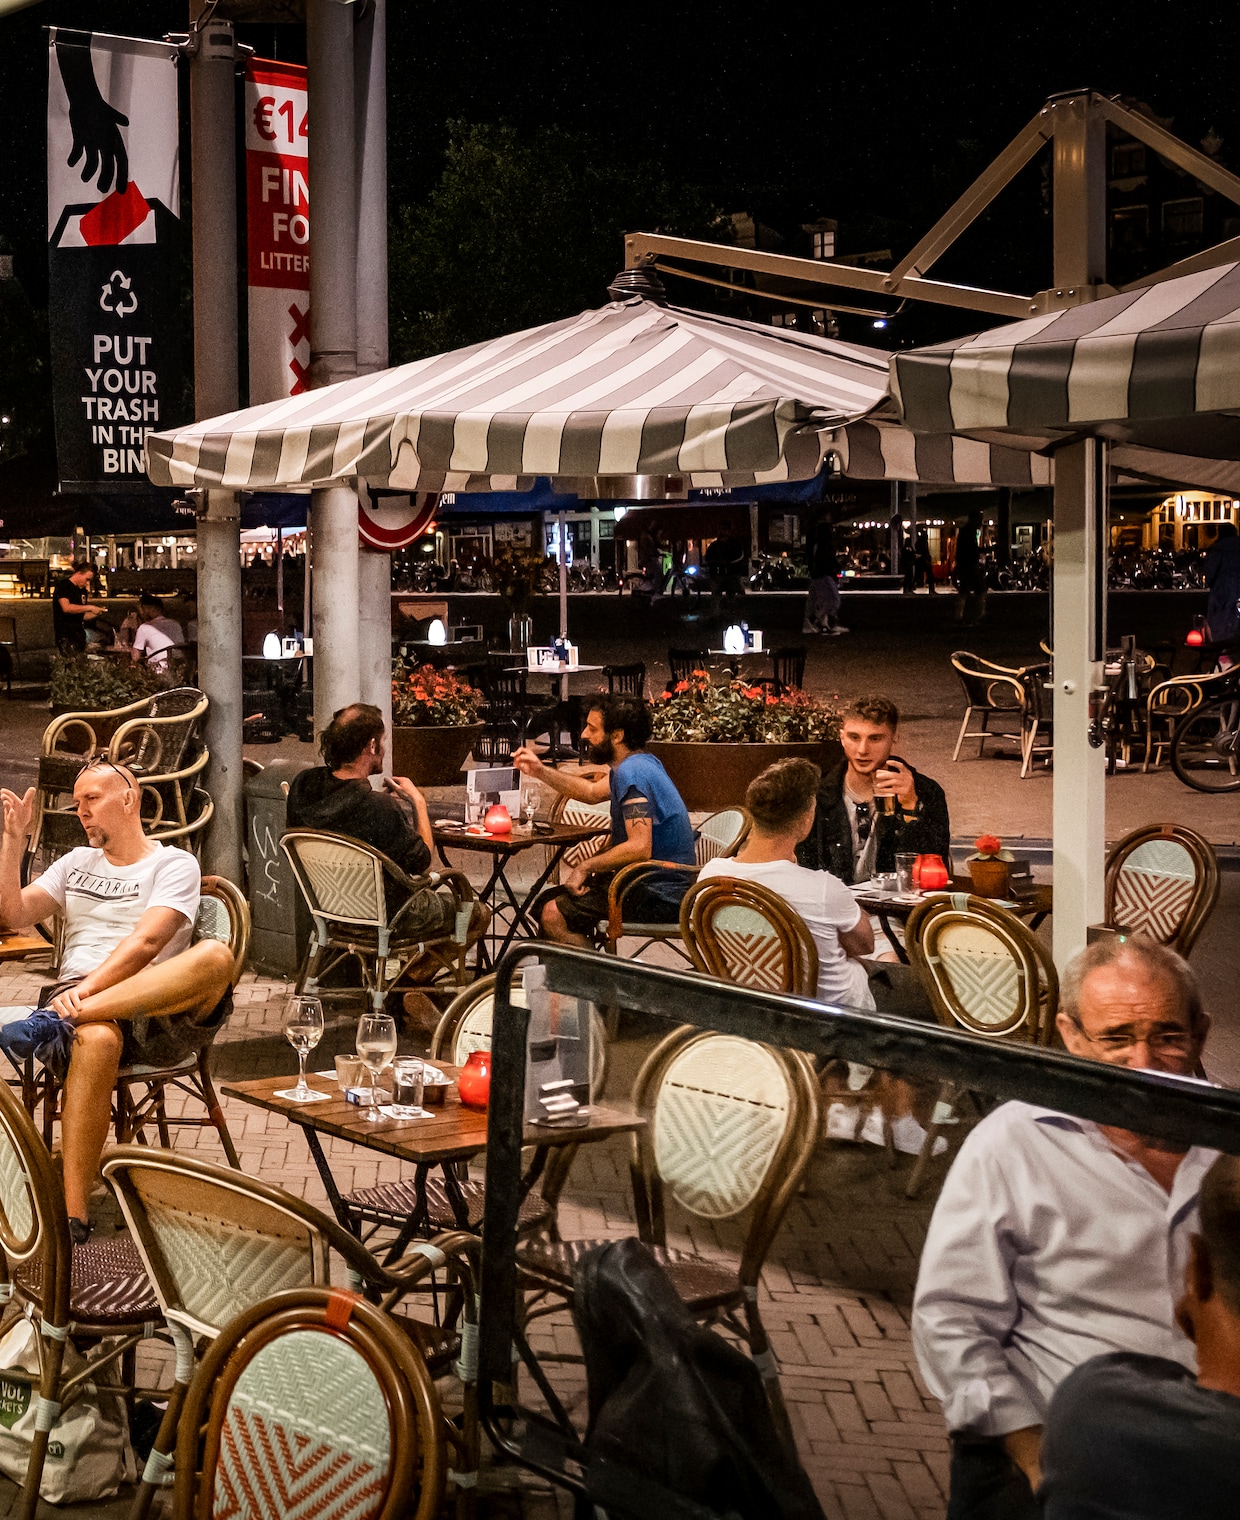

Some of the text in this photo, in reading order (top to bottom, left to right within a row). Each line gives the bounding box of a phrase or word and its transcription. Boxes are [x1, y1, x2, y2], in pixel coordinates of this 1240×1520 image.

[253, 96, 308, 144] €14
[262, 166, 309, 206] FIN
[273, 212, 309, 245] FO
[261, 251, 309, 273] LITTER
[93, 334, 152, 366] PUT
[84, 368, 157, 394] YOUR
[81, 396, 159, 422] TRASH
[92, 425, 114, 444] IN
[103, 448, 146, 474] BIN
